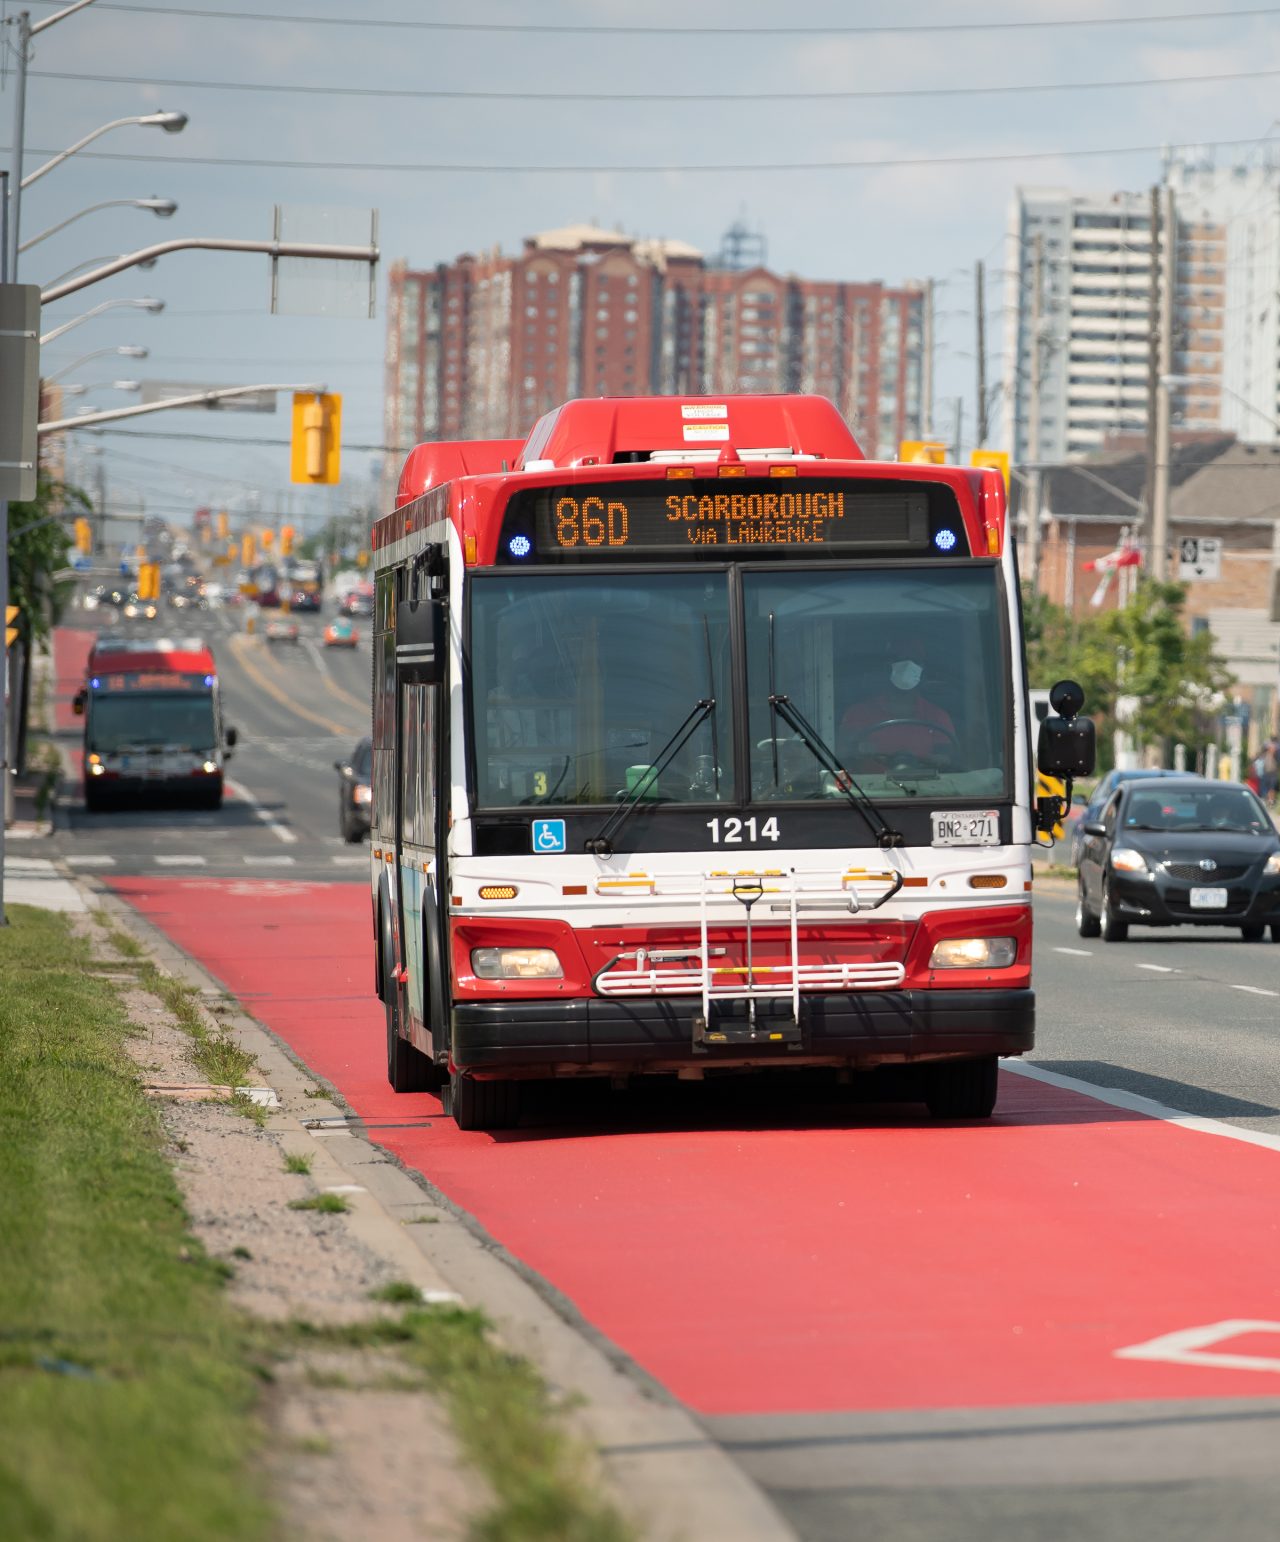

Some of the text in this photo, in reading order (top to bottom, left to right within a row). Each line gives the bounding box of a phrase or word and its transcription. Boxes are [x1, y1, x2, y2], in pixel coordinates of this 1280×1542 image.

[665, 492, 844, 521] SCARBOROUGH
[556, 496, 629, 547] 86D
[727, 520, 824, 544] LAWRENCE
[533, 771, 547, 796] 3
[706, 816, 781, 844] 1214
